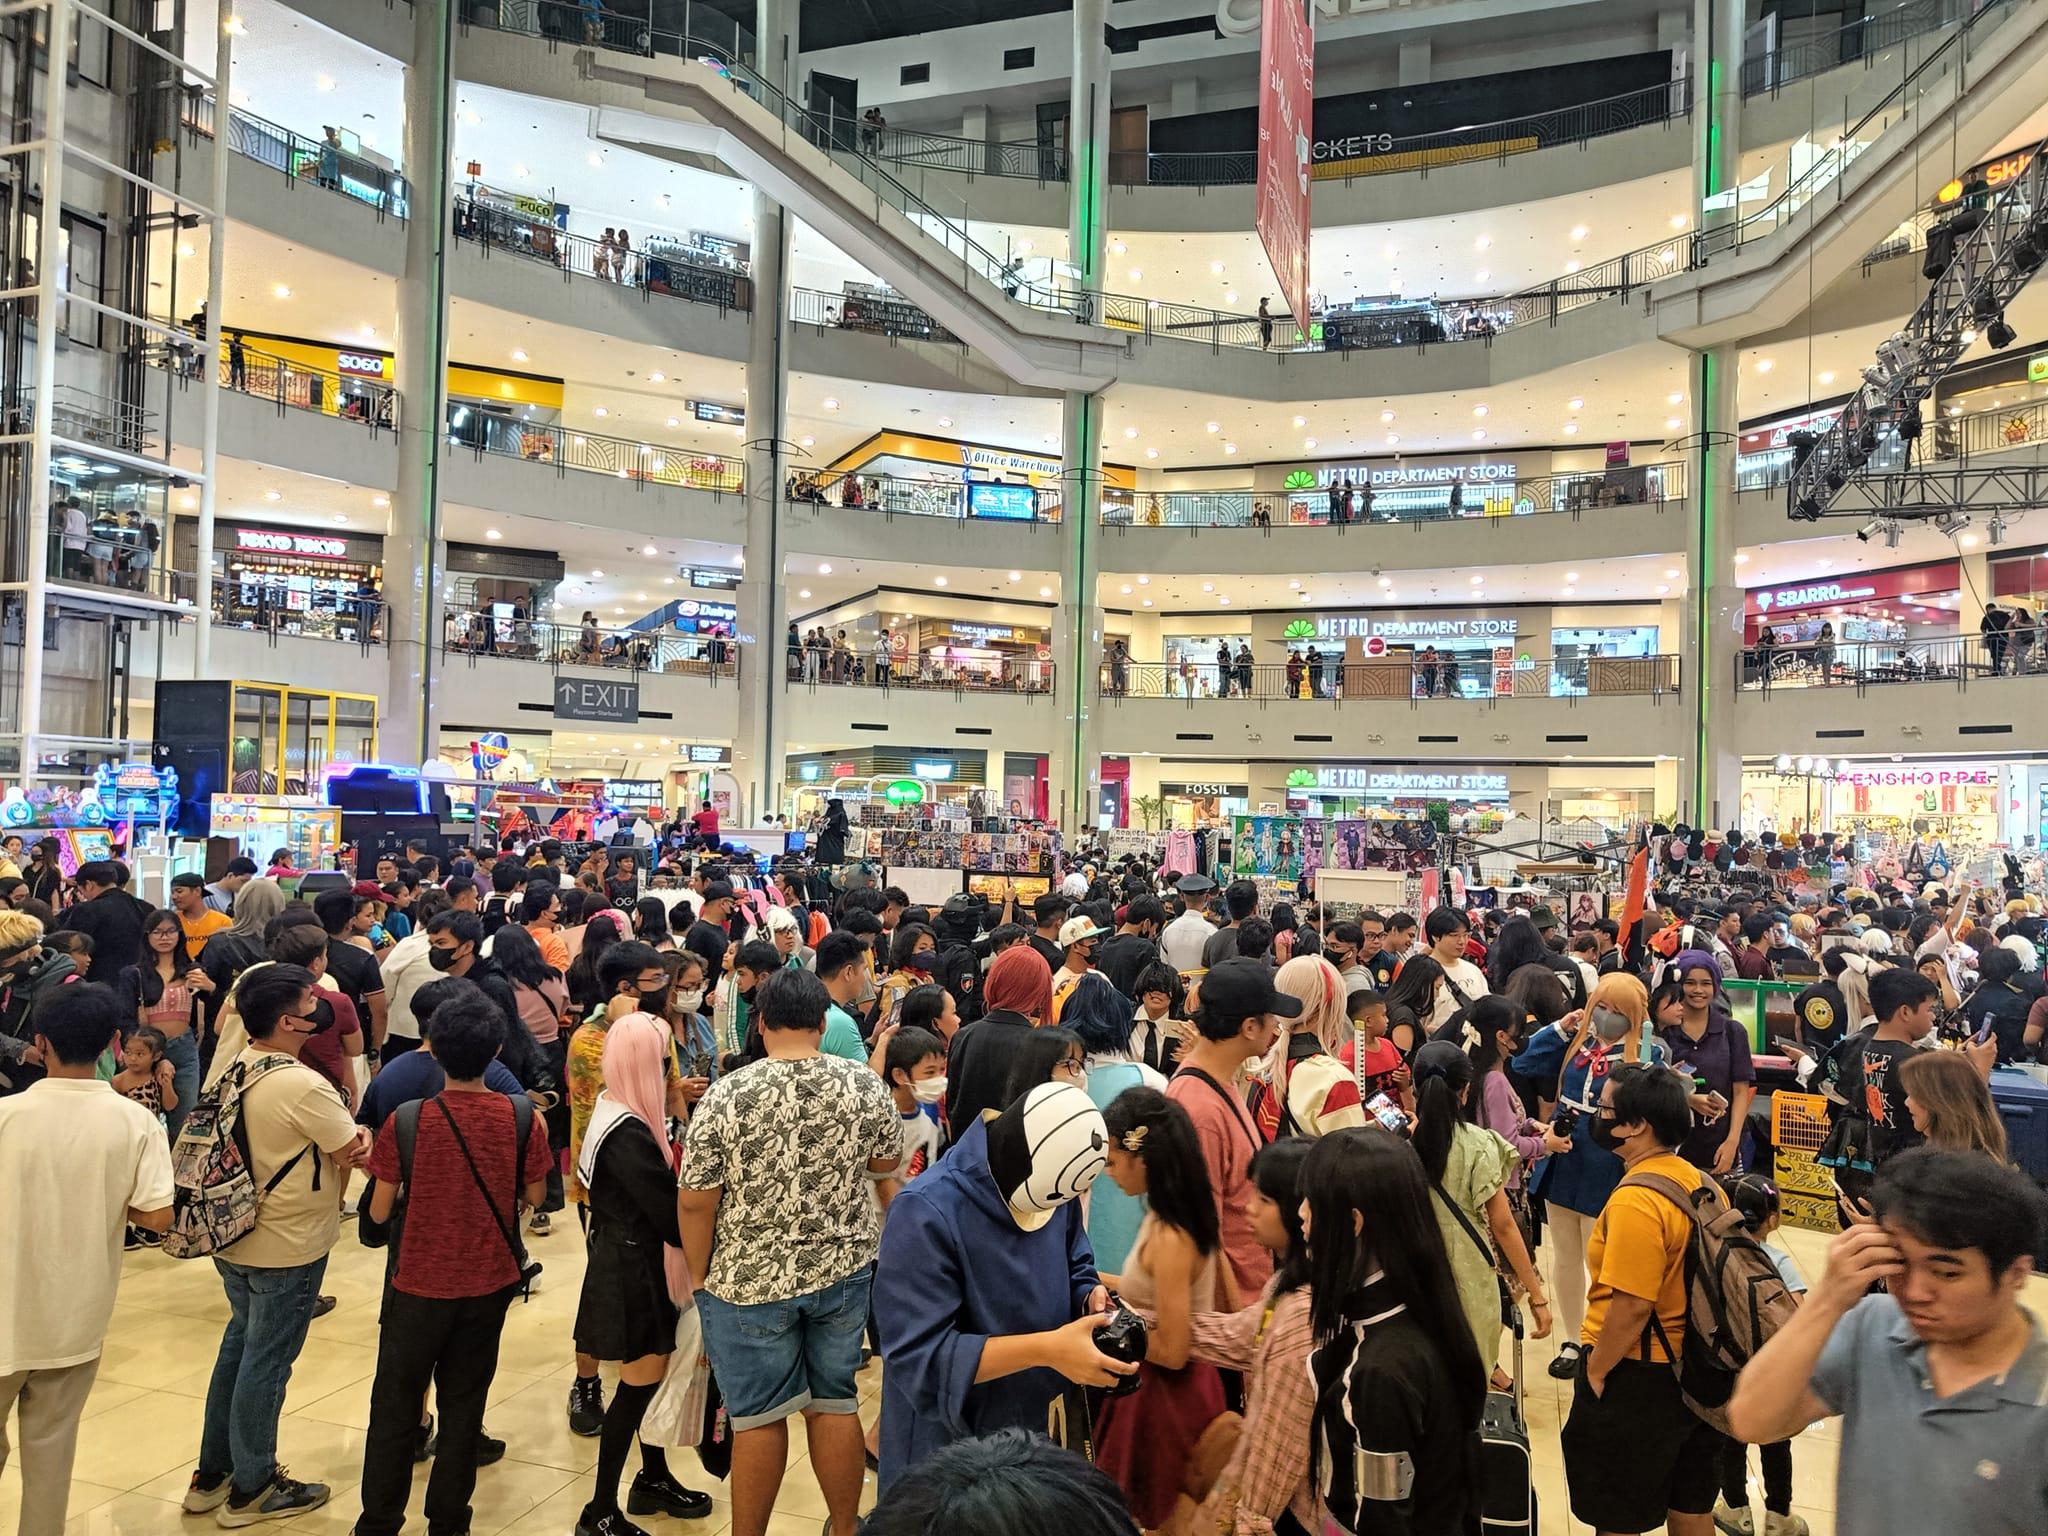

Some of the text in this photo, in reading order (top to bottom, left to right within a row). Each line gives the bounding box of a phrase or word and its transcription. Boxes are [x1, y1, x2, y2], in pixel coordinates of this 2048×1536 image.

[520, 200, 550, 217] POCO
[339, 354, 383, 373] SOGO
[688, 400, 694, 410] 3
[974, 452, 1007, 466] Office
[1318, 464, 1517, 487] METRO DEPARTMENT STORE
[238, 532, 346, 556] TOKYO TOKYO
[682, 568, 690, 578] 2
[1776, 584, 1841, 607] SBARRO
[1318, 618, 1518, 636] METRO DEPARTMENT STORE
[581, 683, 635, 709] EXIT
[681, 744, 688, 754] 1
[1318, 769, 1507, 789] METRO DEPARTMENT STORE
[1836, 770, 1988, 786] PENSHOPPE
[1185, 784, 1230, 795] FOSSIL
[766, 1062, 795, 1081] AM
[835, 1096, 861, 1116] AM
[773, 1105, 801, 1128] AM
[835, 1145, 861, 1164] AM
[775, 1154, 801, 1175] AM
[829, 1190, 851, 1207] AM
[774, 1200, 802, 1222] AM
[831, 1255, 854, 1277] AM
[769, 1276, 798, 1299] AM
